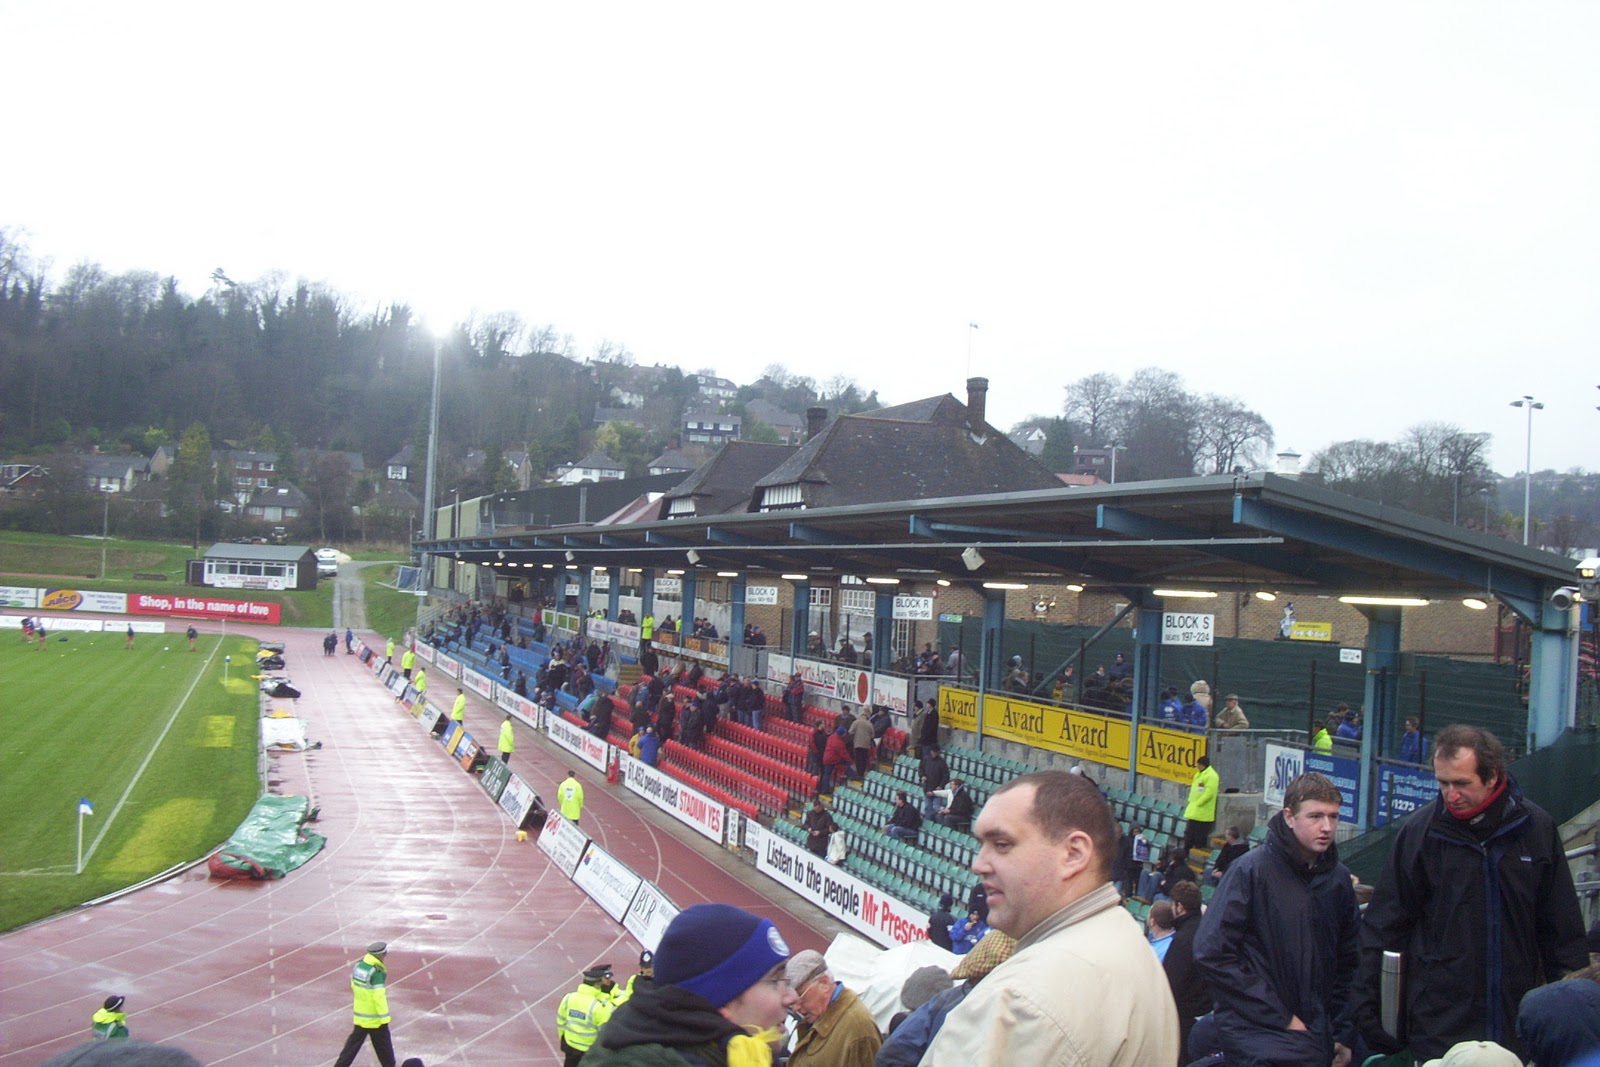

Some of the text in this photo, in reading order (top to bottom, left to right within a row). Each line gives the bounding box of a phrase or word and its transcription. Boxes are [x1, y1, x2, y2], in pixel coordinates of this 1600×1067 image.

[139, 595, 269, 615] Shop, in the name of love
[748, 587, 768, 596] BLOCK
[895, 597, 929, 608] BLOCK R
[1165, 615, 1210, 630] BLOCK S
[1181, 631, 1210, 642] 197-224
[943, 690, 977, 718] Avard
[1001, 701, 1045, 734] Avard
[1059, 713, 1109, 749] Avard
[1143, 730, 1199, 769] Avard
[679, 790, 707, 825] STADIUM
[707, 804, 720, 833] YES
[766, 838, 930, 945] Listen to the people Mr Presco
